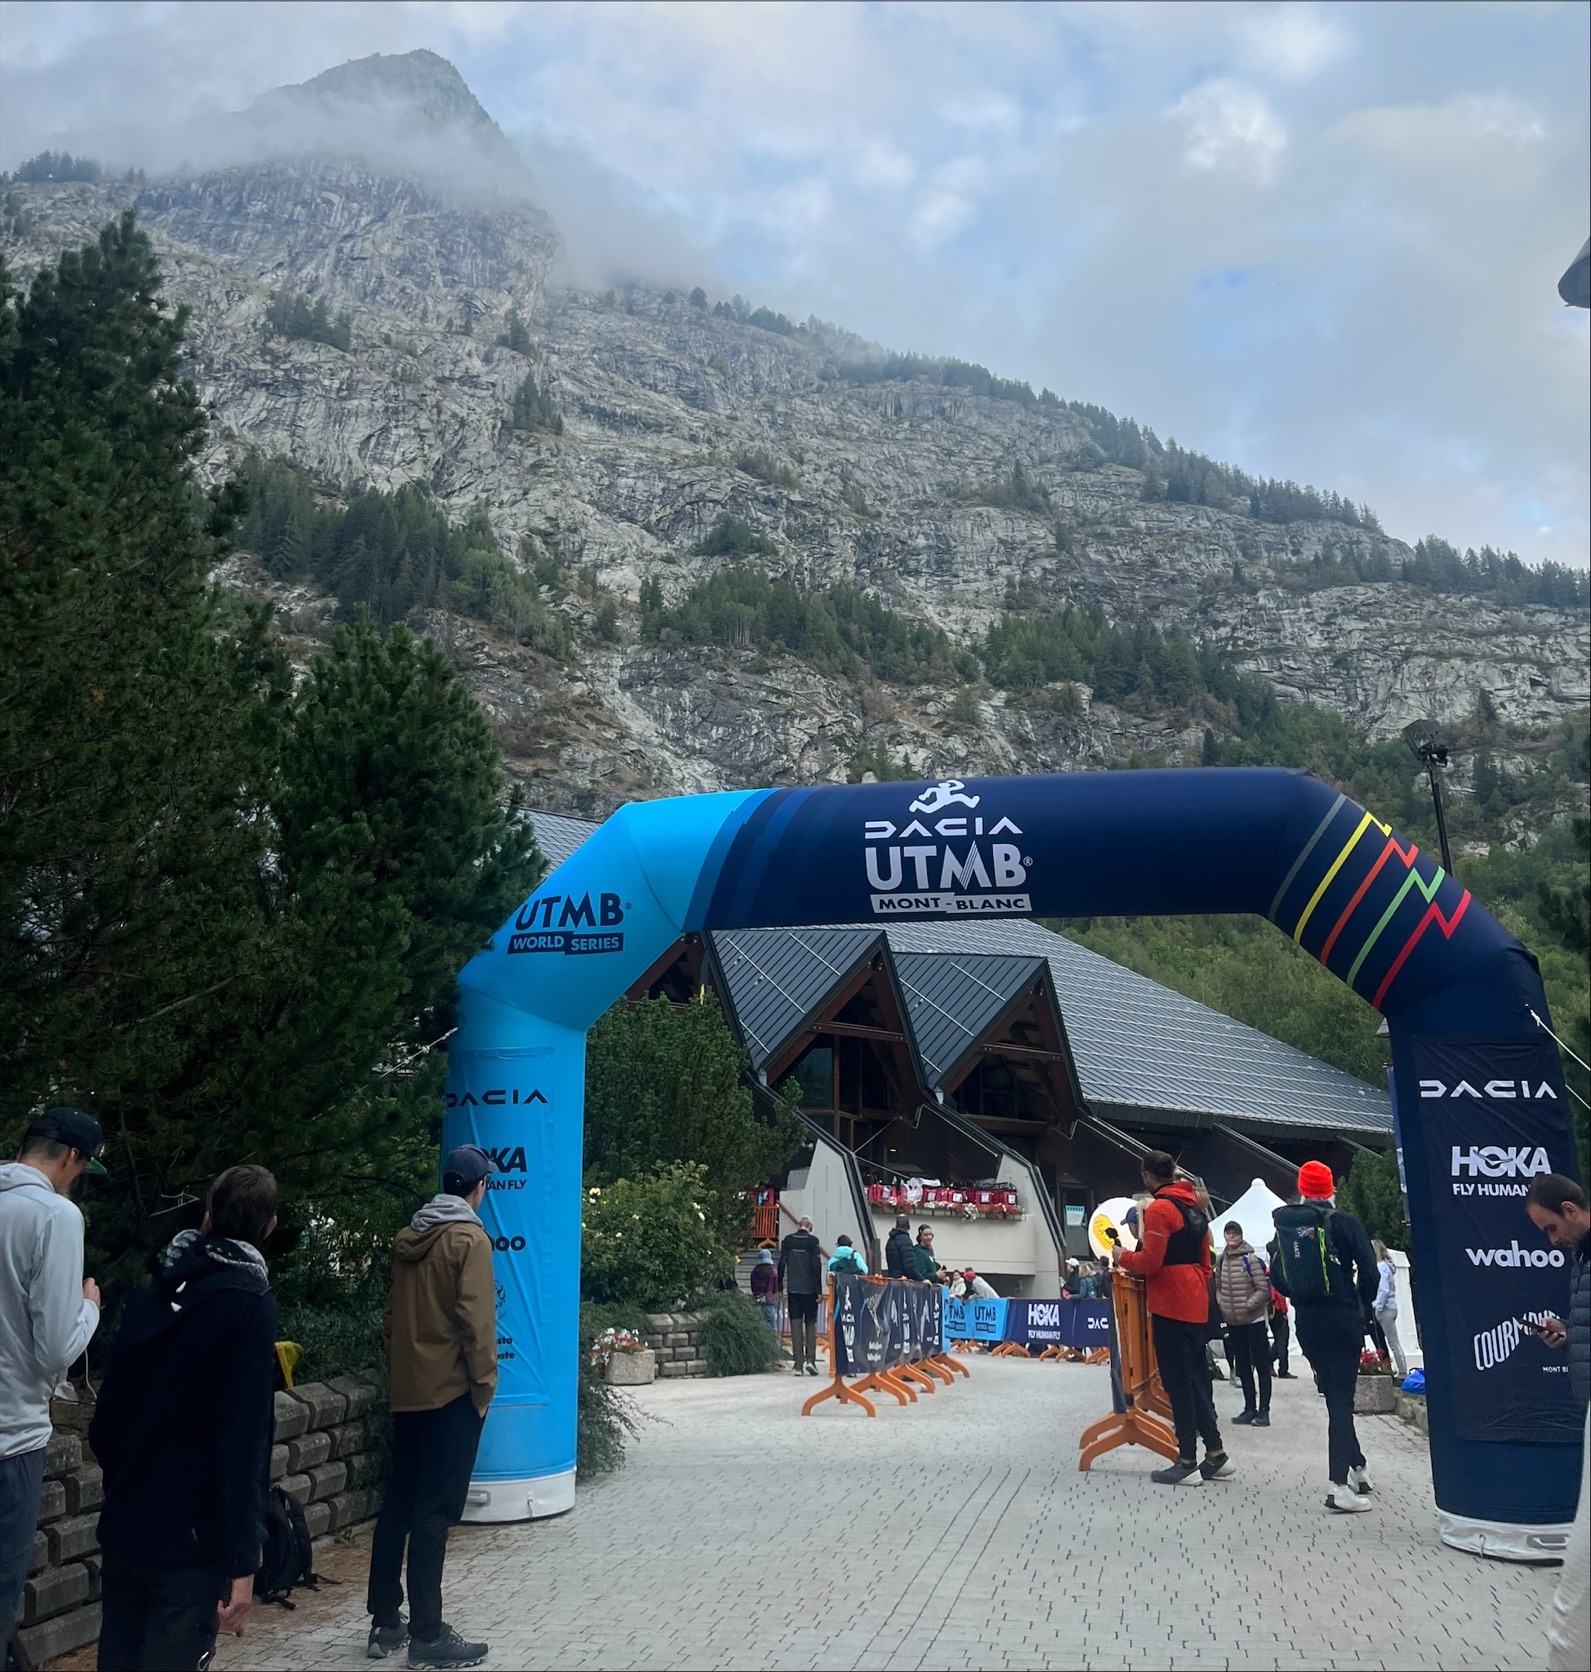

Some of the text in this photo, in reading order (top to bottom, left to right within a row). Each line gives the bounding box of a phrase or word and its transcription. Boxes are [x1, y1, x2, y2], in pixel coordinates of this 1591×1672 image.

[865, 816, 1024, 840] DACIA
[513, 936, 620, 951] WORLD SERIES
[1418, 1079, 1558, 1099] DACIA
[1451, 1145, 1552, 1178] HOKA
[508, 1179, 527, 1190] FLY
[1452, 1183, 1475, 1196] FLY
[1464, 1240, 1566, 1268] wahoo
[974, 1305, 997, 1322] UTMB
[1027, 1303, 1060, 1327] HOKA
[1087, 1317, 1109, 1330] DAC
